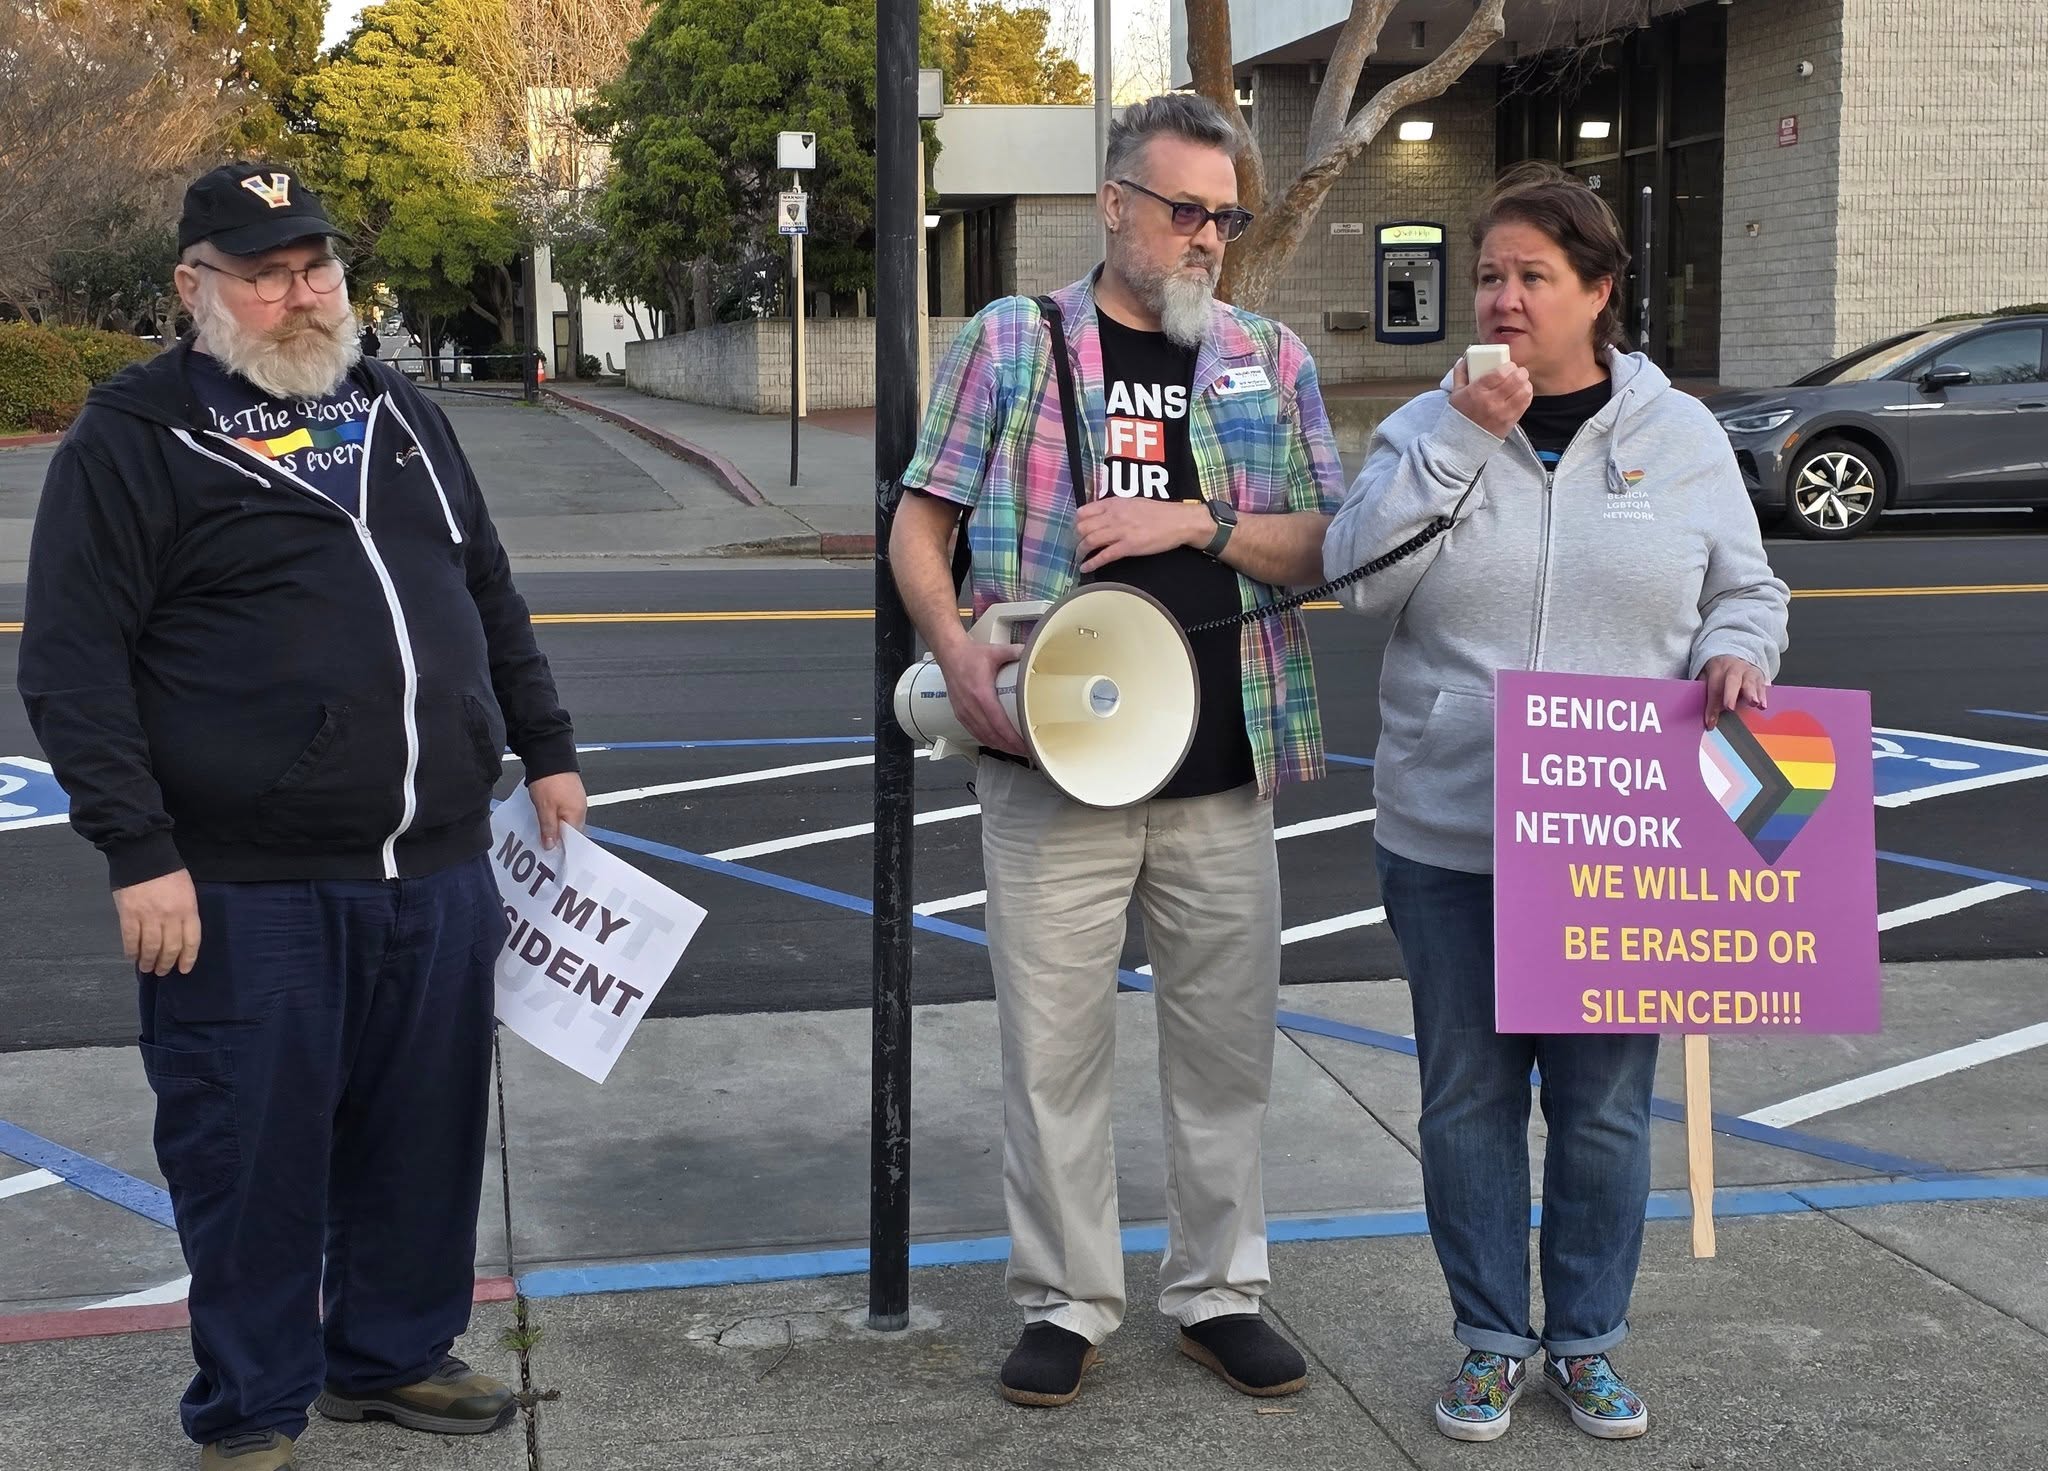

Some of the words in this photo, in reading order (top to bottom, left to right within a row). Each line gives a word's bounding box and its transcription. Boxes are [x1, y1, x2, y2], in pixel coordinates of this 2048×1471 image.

[234, 402, 291, 433] The
[1106, 380, 1187, 419] ANS
[306, 443, 364, 472] ever
[1105, 420, 1158, 459] FF
[1603, 511, 1655, 521] NETWORK
[1606, 501, 1651, 509] LGBTQIA
[1527, 694, 1662, 733] BENICIA
[1522, 752, 1667, 796] LGBTQIA
[1515, 810, 1682, 849] NETWORK
[496, 830, 555, 897] NOT
[551, 885, 630, 945] MY
[1569, 863, 1624, 899] WE
[1633, 865, 1718, 902] WILL
[1728, 869, 1801, 903] NOT
[503, 905, 644, 1017] SIDENT
[1564, 926, 1610, 961] BE
[1621, 927, 1758, 963] ERASED
[1768, 931, 1817, 964] OR
[1581, 989, 1802, 1025] SILENCED!!!!
